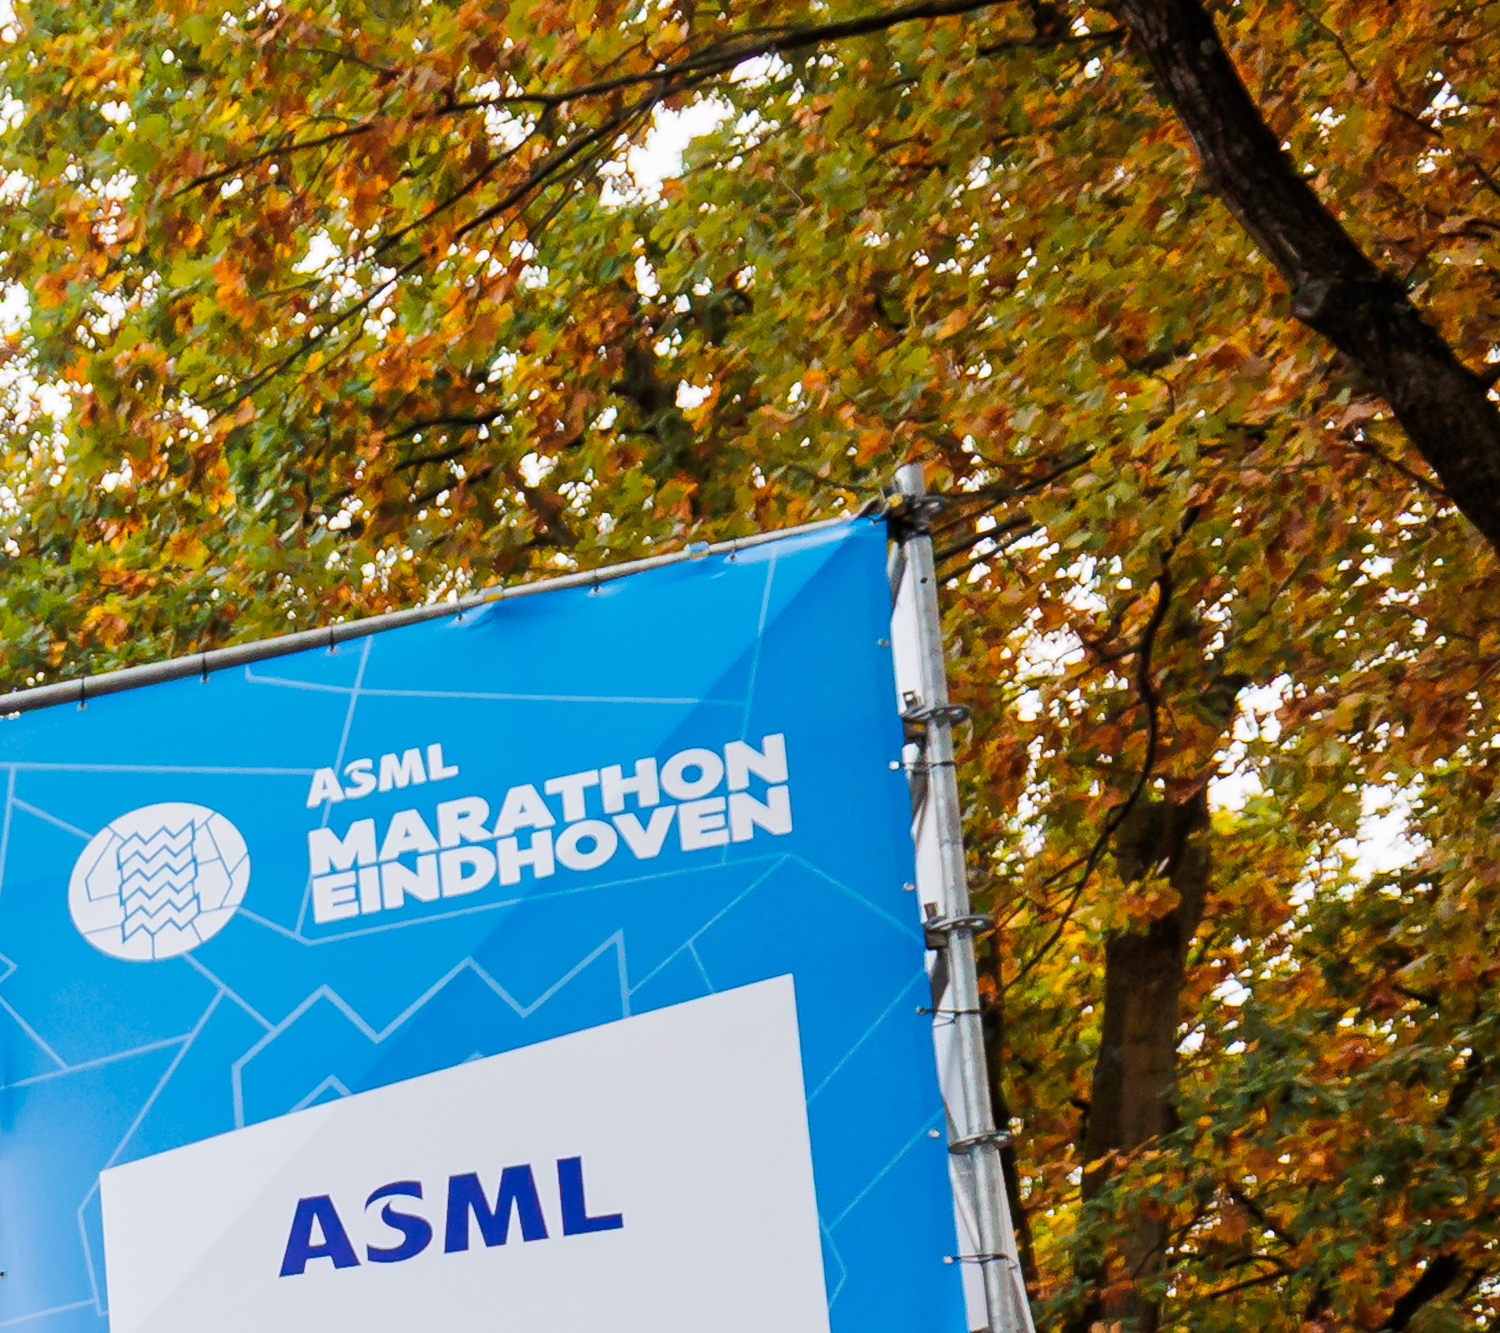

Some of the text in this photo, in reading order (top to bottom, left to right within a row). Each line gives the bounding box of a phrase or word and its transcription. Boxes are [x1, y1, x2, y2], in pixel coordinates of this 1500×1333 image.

[306, 743, 459, 809] ASML
[307, 732, 789, 876] MARATHON
[312, 786, 793, 924] EINDHOVEN
[279, 1155, 625, 1279] ASML
